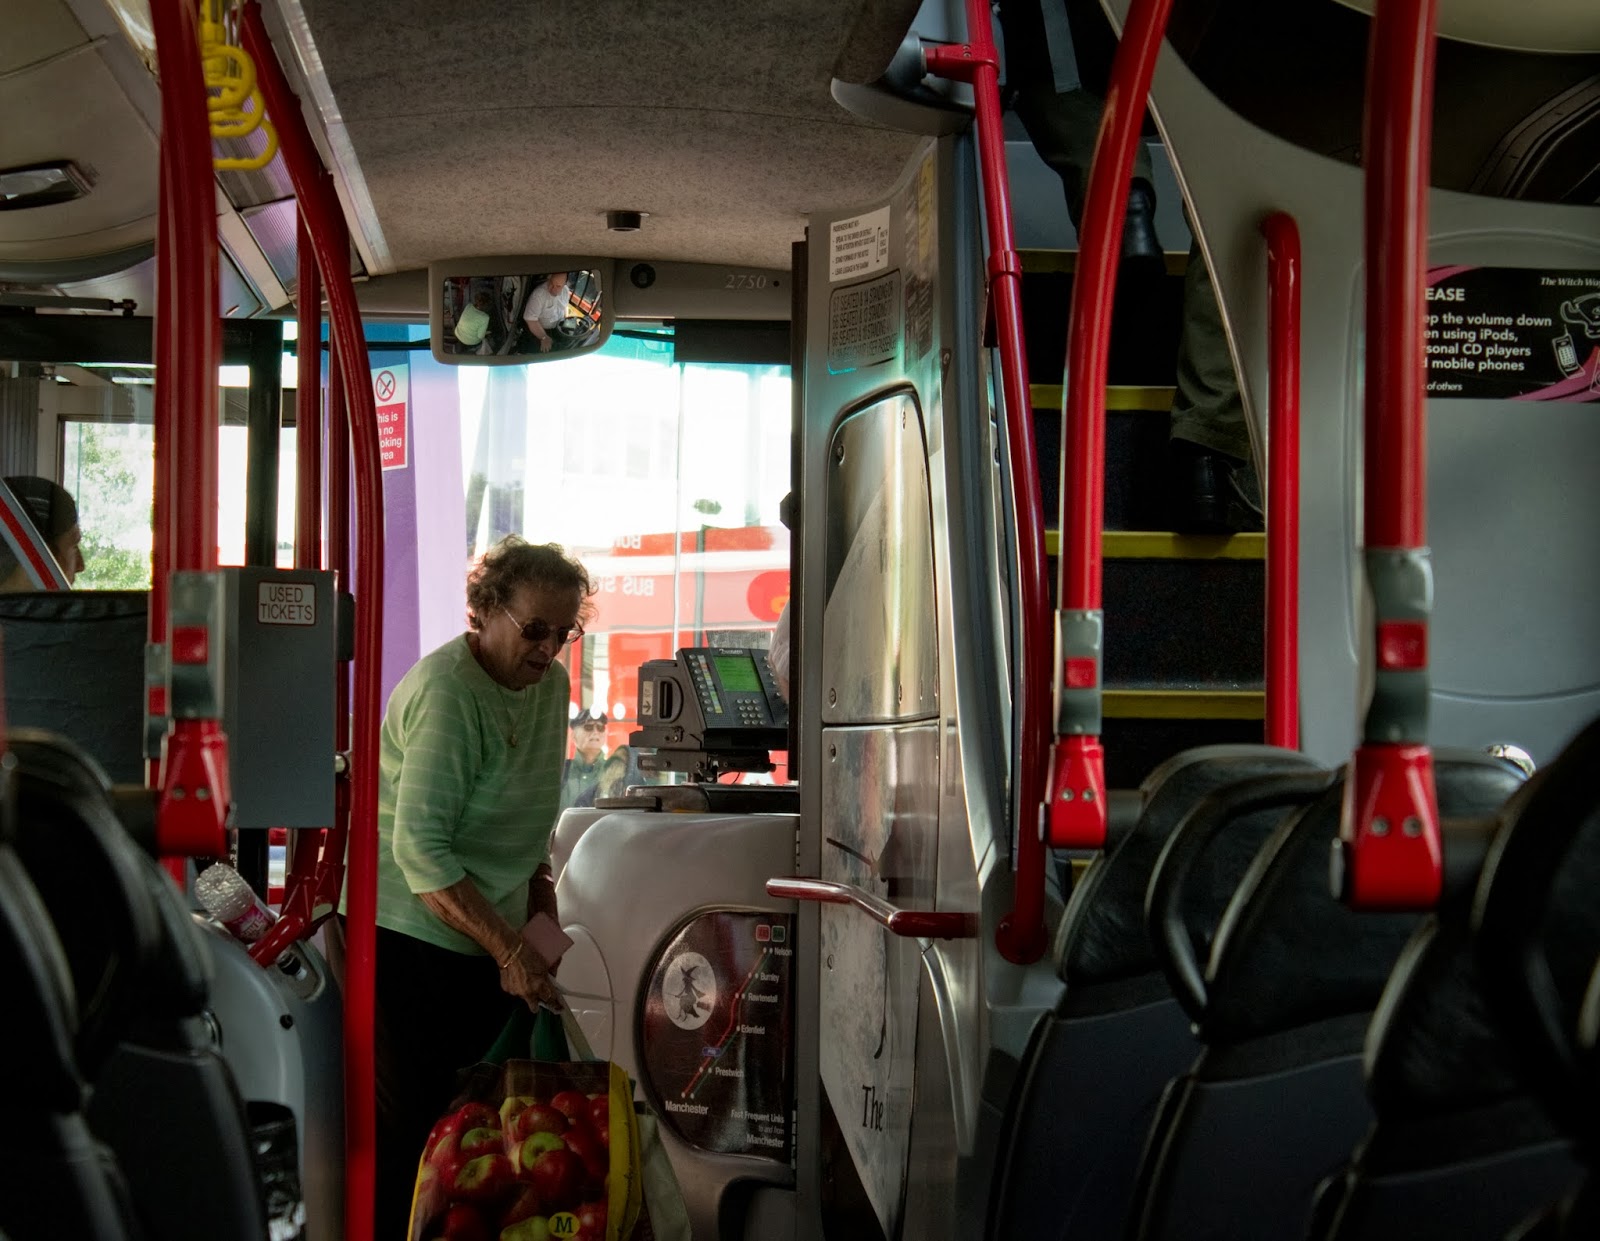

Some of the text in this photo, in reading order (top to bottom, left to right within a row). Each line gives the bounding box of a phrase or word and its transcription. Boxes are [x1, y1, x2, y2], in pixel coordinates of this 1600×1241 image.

[725, 274, 767, 289] 2750
[1540, 276, 1556, 286] The
[1557, 277, 1583, 287] Witch
[1424, 288, 1466, 301] EASE
[1423, 312, 1552, 327] ep the volume down
[1423, 328, 1519, 343] en using iPods,
[1425, 343, 1532, 359] sonal CD players
[1431, 358, 1475, 370] mobile
[1478, 359, 1525, 372] phones
[1436, 381, 1463, 391] others
[377, 412, 398, 423] his is
[383, 427, 394, 435] no
[380, 437, 402, 448] oking
[381, 451, 394, 461] rea
[269, 586, 304, 603] USED
[260, 602, 313, 621] TICKETS
[774, 947, 793, 957] Nelson
[760, 972, 780, 984] Burnley
[740, 1024, 766, 1035] Edenfield
[715, 1066, 745, 1078] Prestwich
[665, 1100, 710, 1116] Manchester
[862, 1084, 884, 1132] The
[730, 1109, 785, 1124] Fast Frequent Links
[746, 1133, 785, 1148] Manchester
[554, 1215, 574, 1234] M
